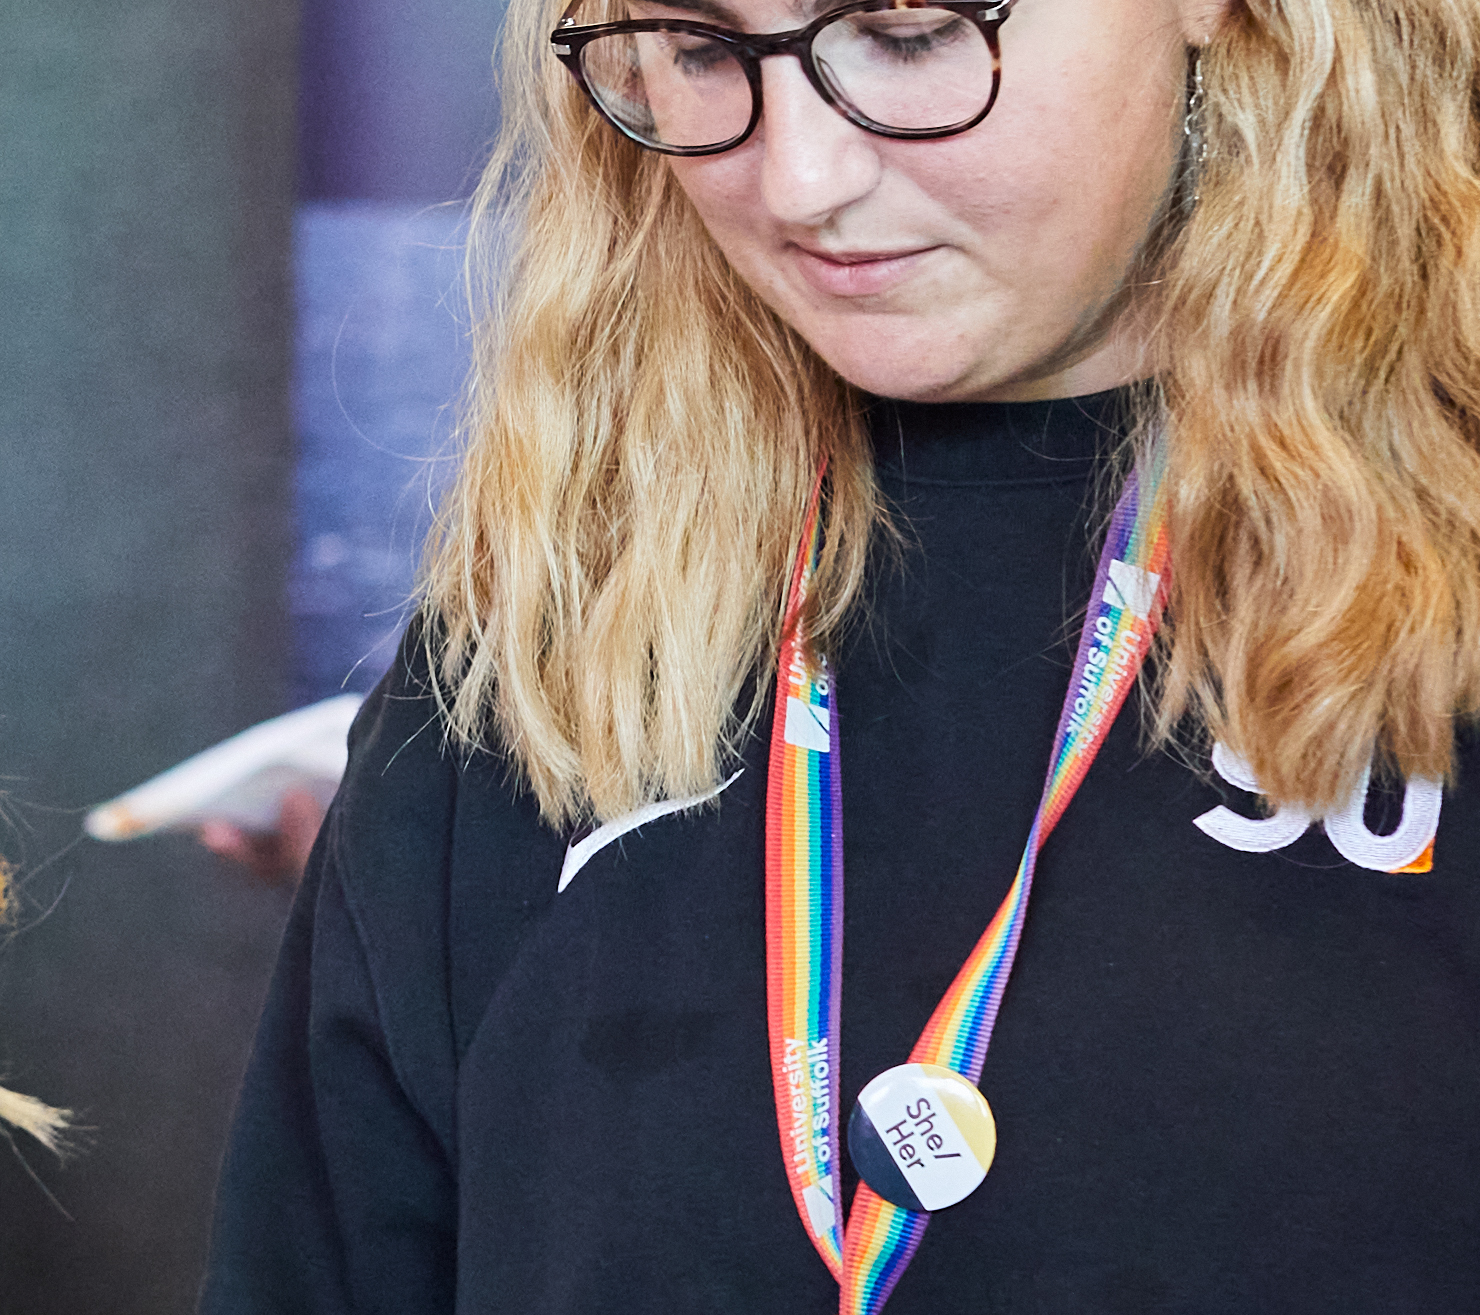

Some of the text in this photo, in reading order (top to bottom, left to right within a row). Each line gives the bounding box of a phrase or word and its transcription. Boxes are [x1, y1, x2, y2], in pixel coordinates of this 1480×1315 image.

[1065, 616, 1113, 736] of Suffolk
[1075, 629, 1141, 757] University
[782, 1037, 810, 1174] University
[807, 1037, 830, 1162] of Suffolk
[885, 1119, 926, 1170] Her
[906, 1097, 962, 1160] She/
